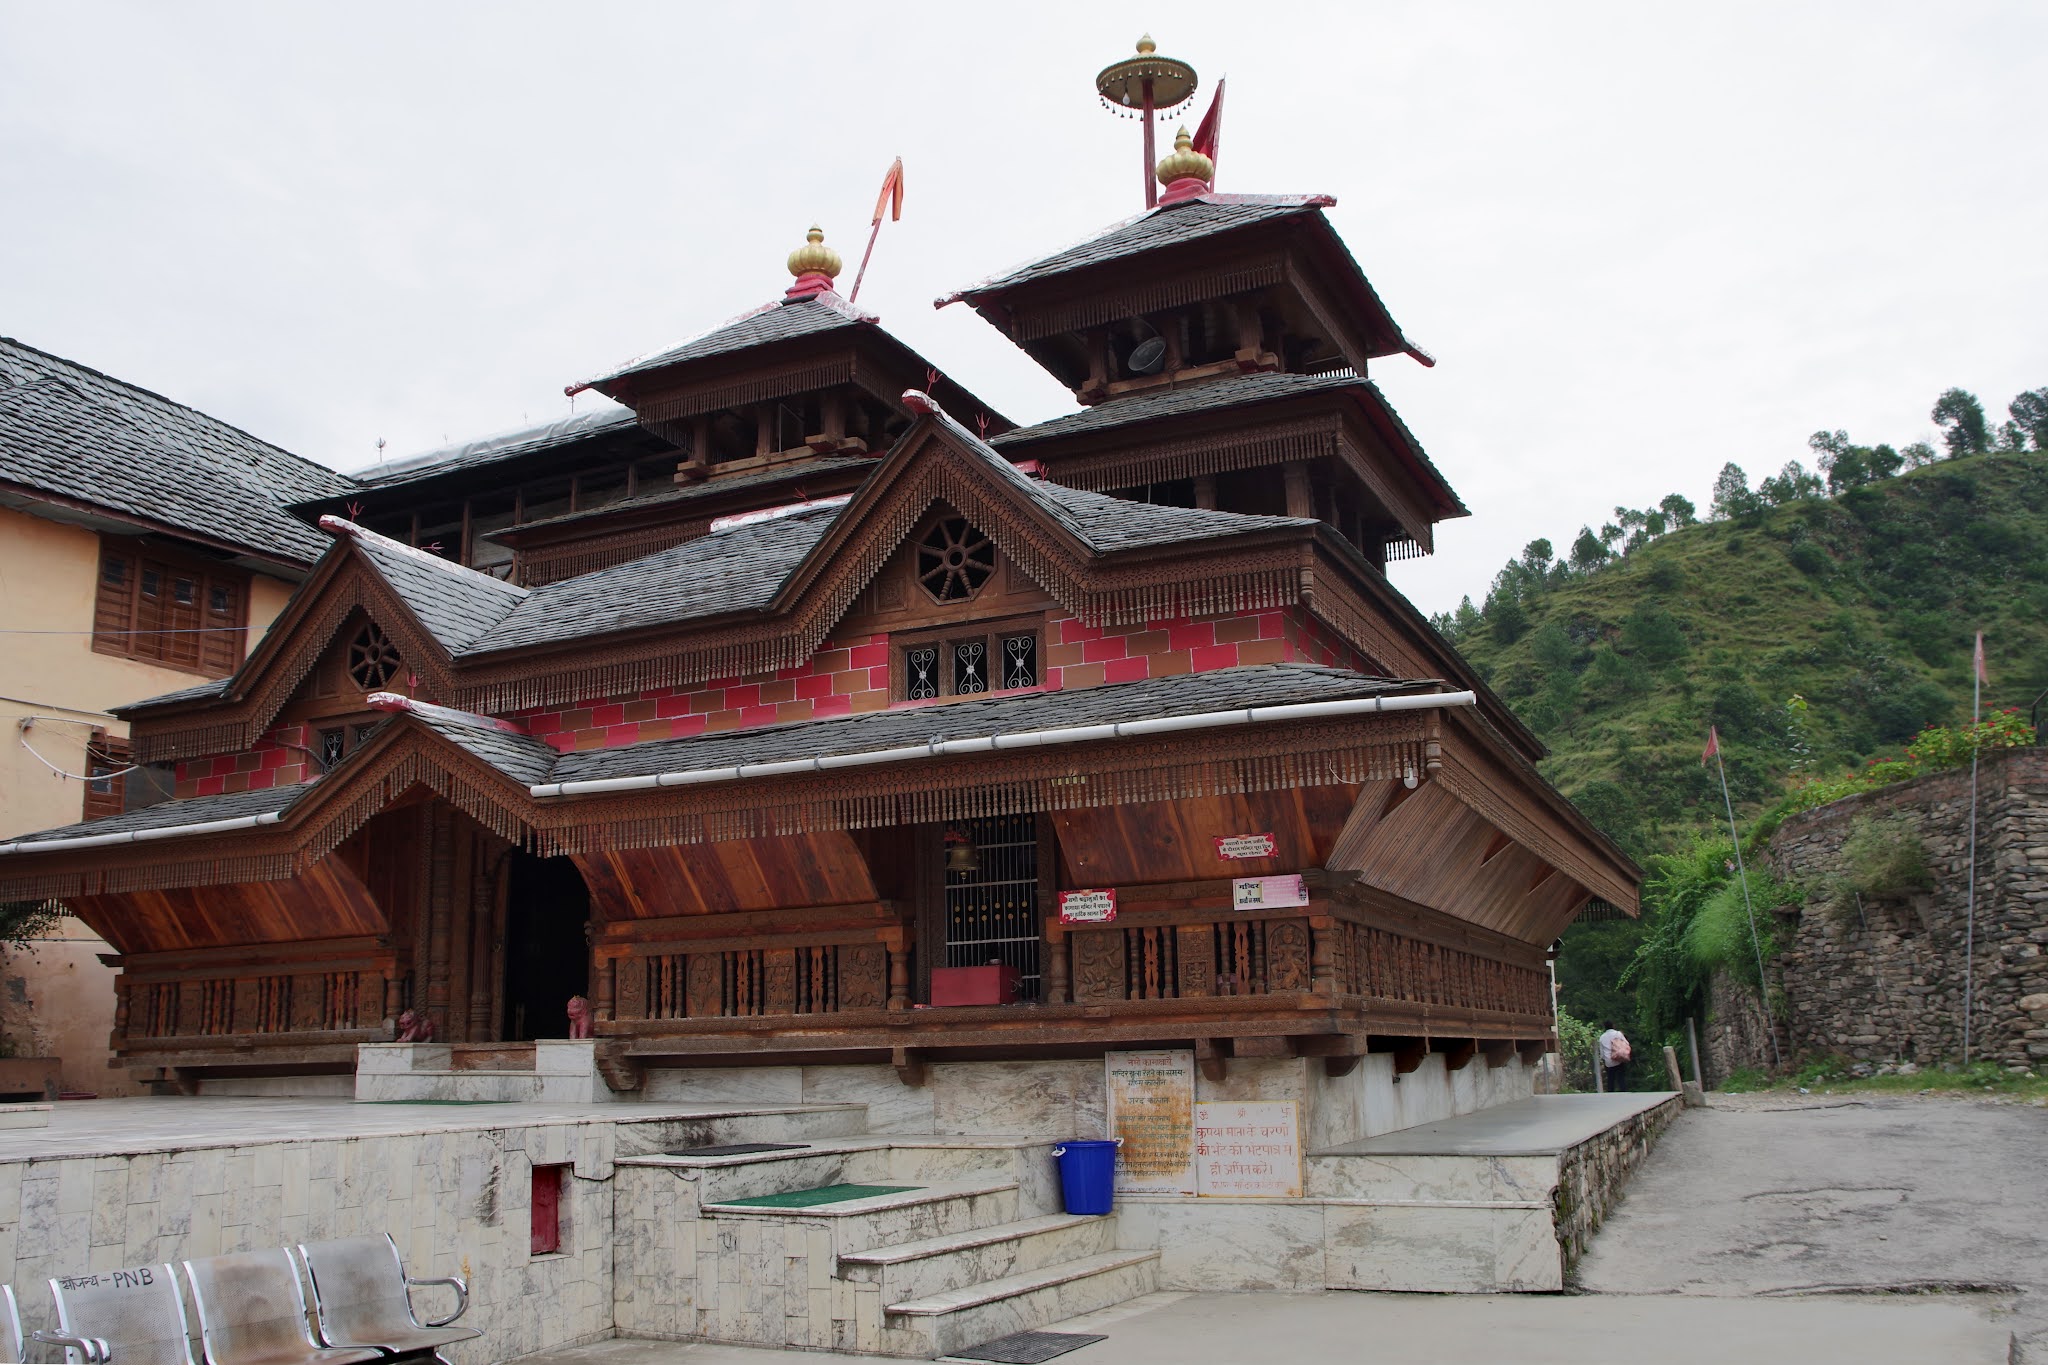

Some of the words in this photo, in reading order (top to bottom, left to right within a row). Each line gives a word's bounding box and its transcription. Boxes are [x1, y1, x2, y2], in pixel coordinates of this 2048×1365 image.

[1156, 1069, 1165, 1077] का
[1196, 1127, 1222, 1140] कृपया
[1197, 1140, 1210, 1156] की
[1210, 1161, 1221, 1175] ही
[112, 1268, 154, 1289] PNB
